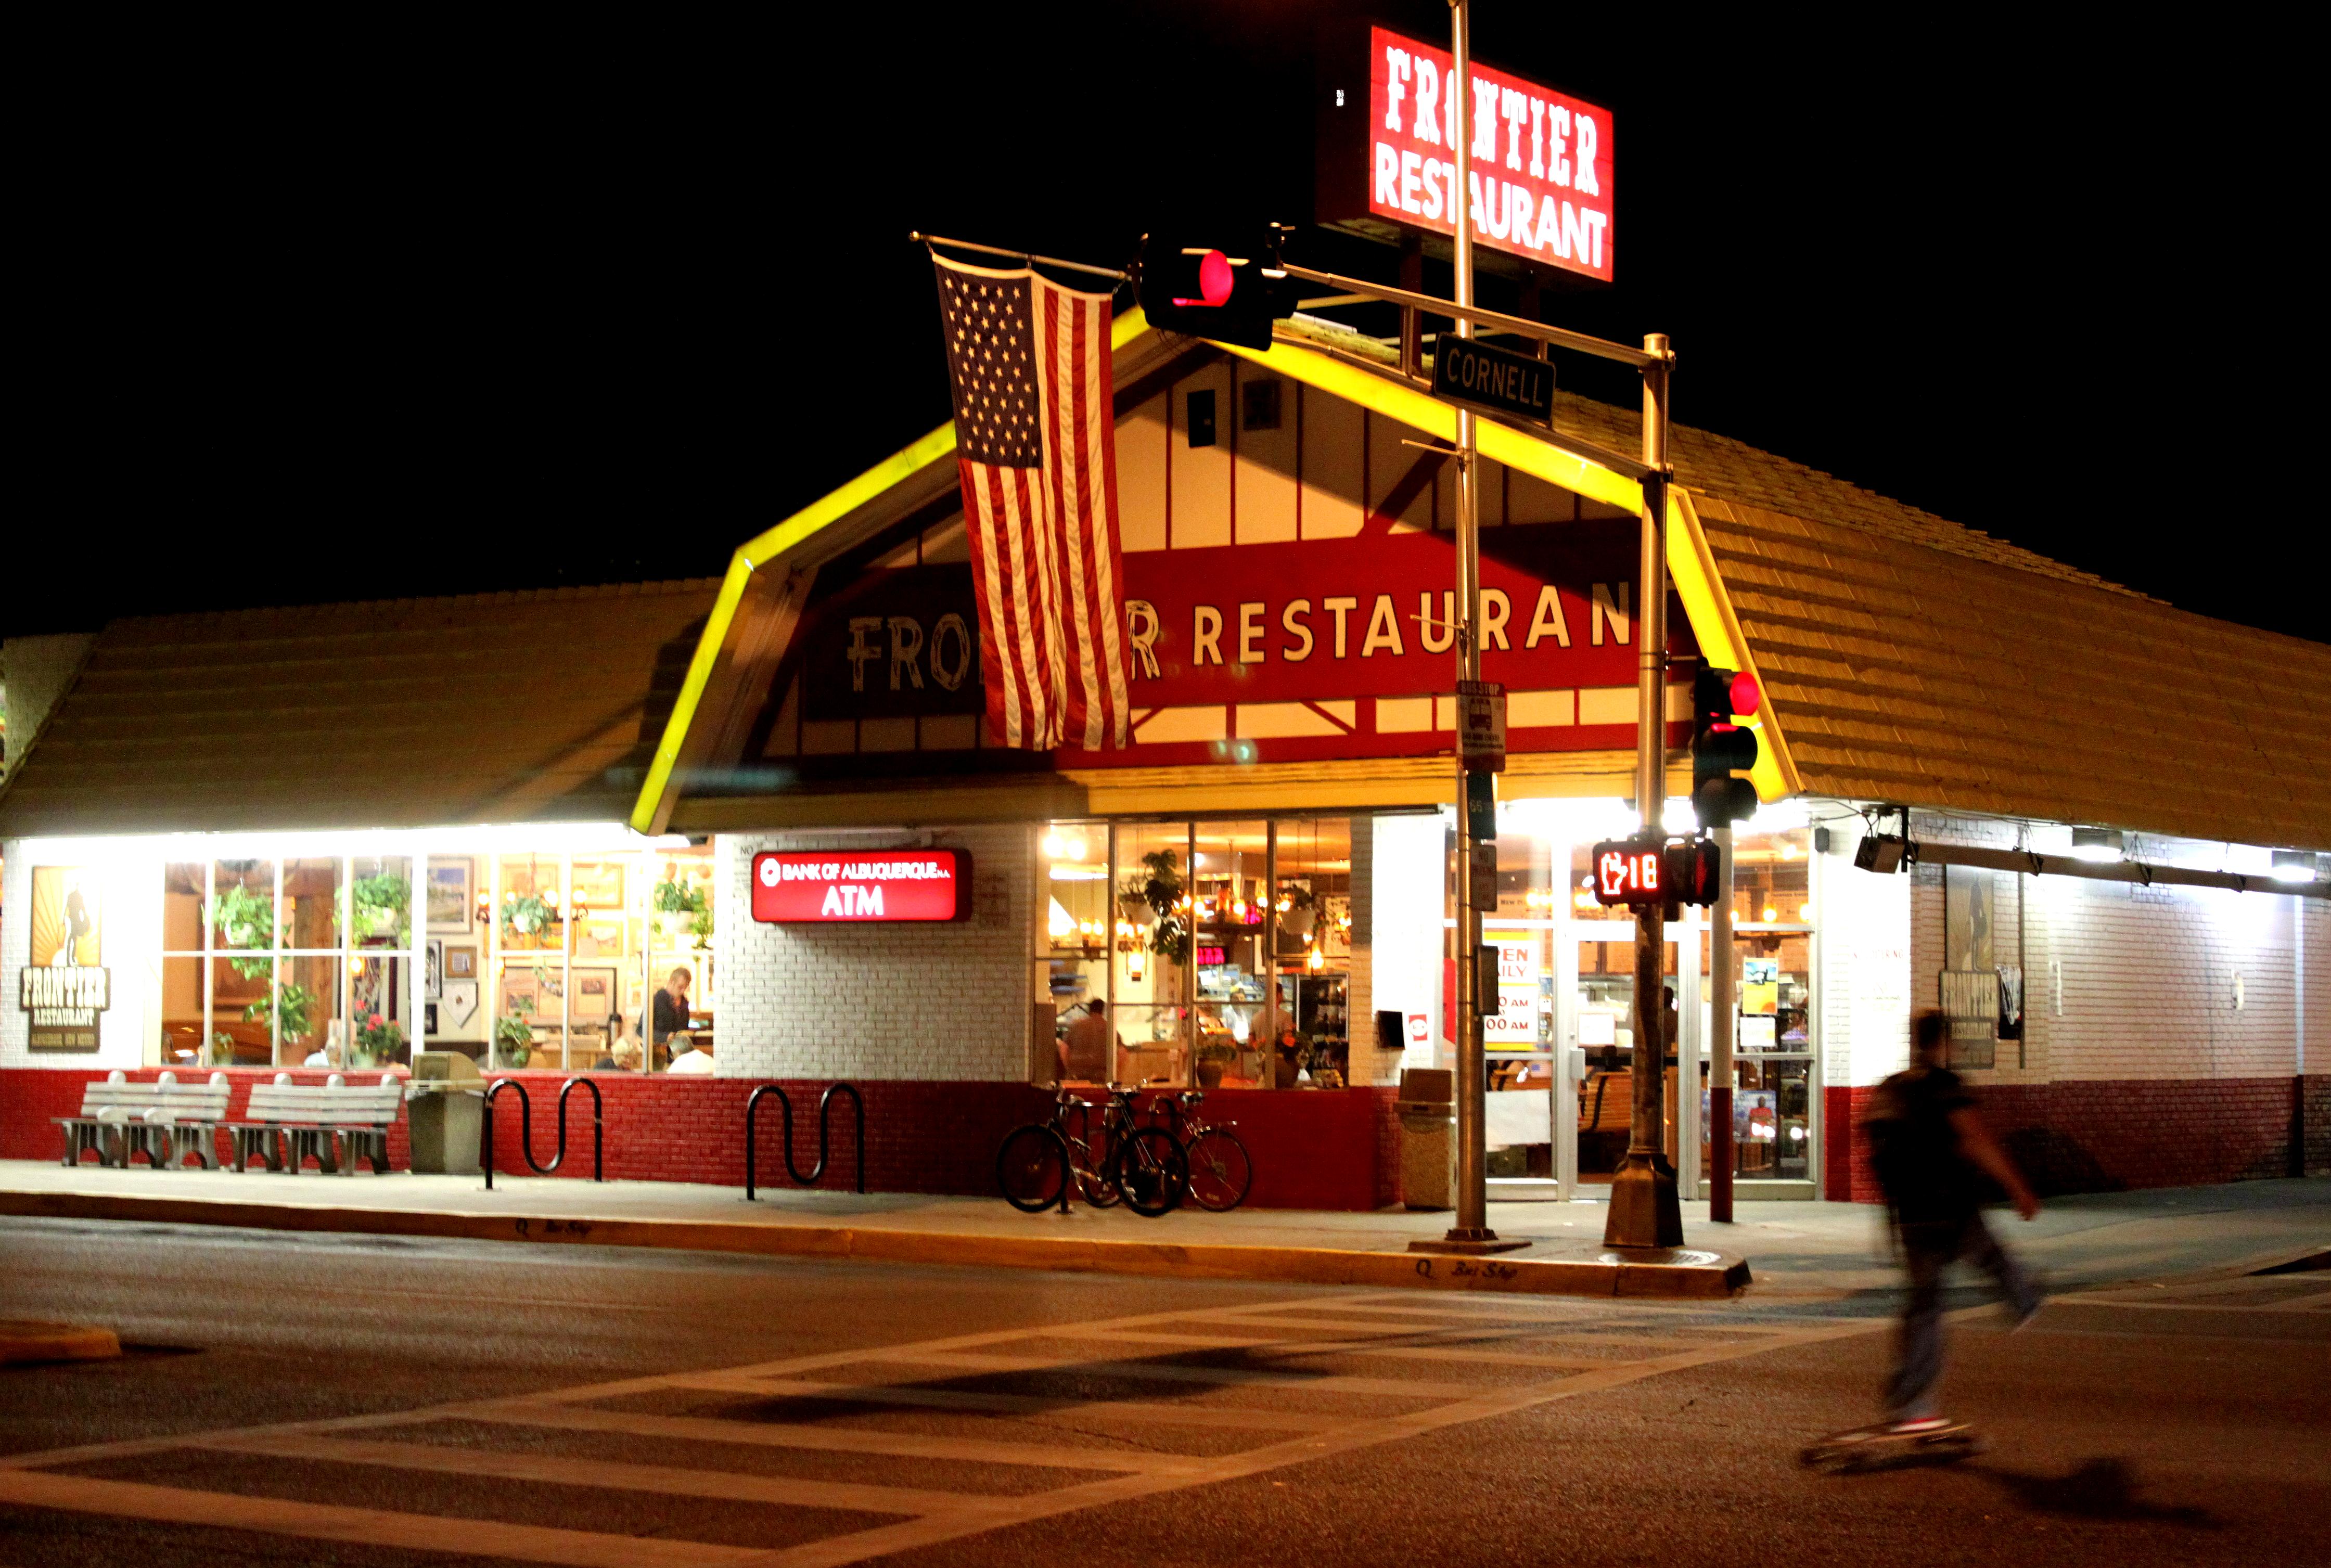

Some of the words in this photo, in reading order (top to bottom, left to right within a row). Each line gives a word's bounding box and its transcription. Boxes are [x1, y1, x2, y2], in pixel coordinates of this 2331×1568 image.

[1447, 347, 1543, 407] CORNELL
[1193, 581, 1677, 666] RESTAURAN
[1478, 683, 1500, 696] STOP
[783, 864, 822, 881] BANK
[822, 863, 841, 880] OF
[841, 862, 938, 880] ALBUQUERQUE
[1630, 855, 1657, 889] 18
[821, 885, 884, 916] ATM
[22, 966, 107, 1008] FRONTIER
[33, 1007, 95, 1027] RESTAURANT
[1511, 1021, 1528, 1030] AM
